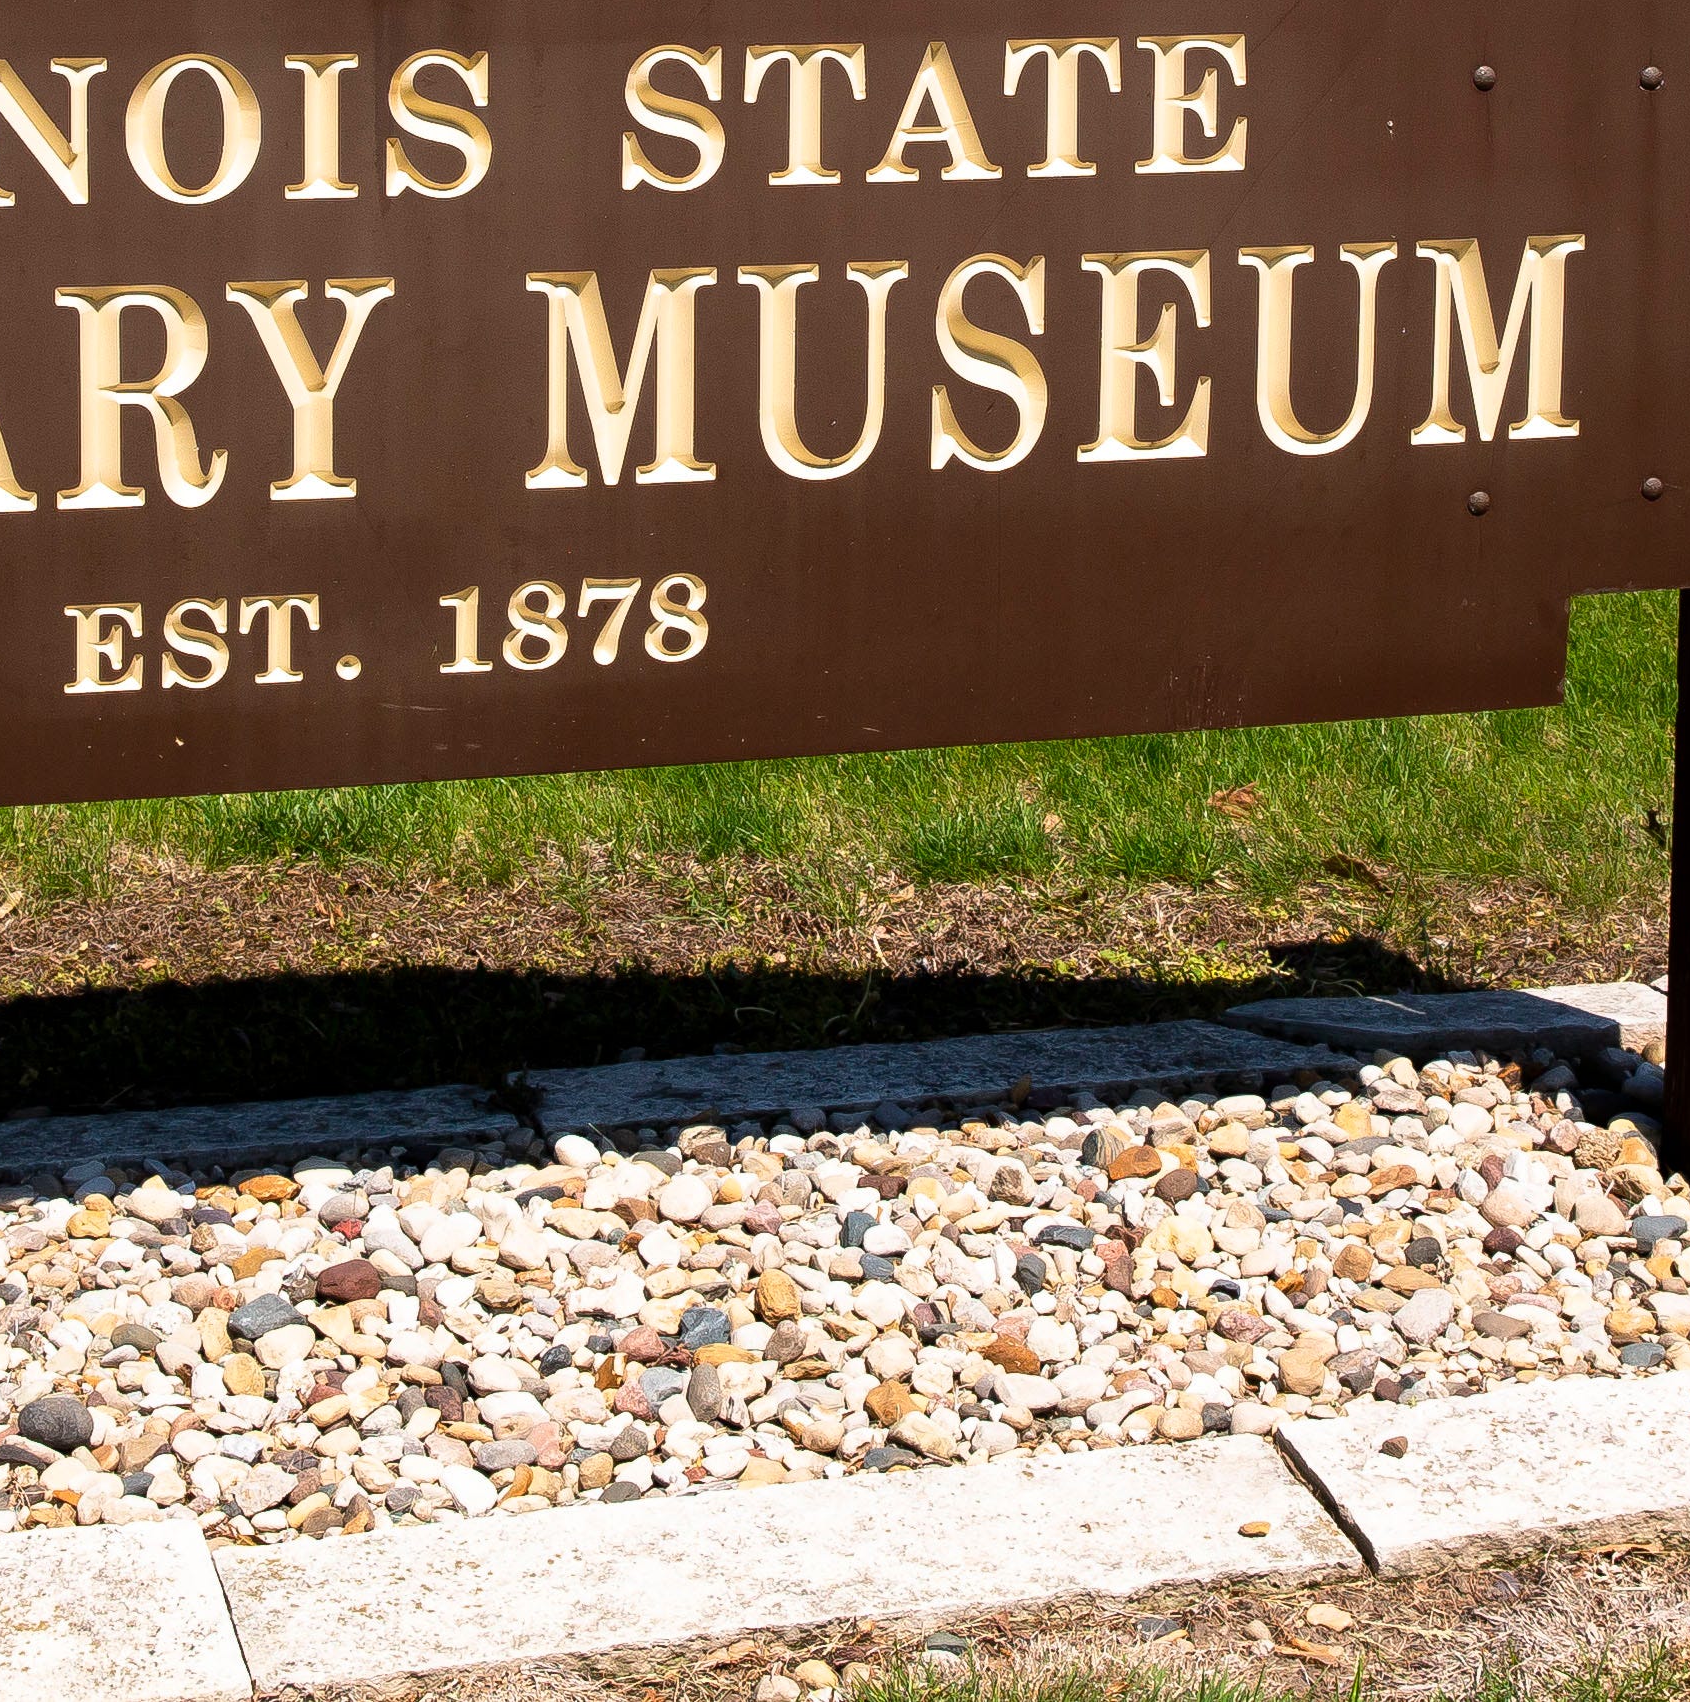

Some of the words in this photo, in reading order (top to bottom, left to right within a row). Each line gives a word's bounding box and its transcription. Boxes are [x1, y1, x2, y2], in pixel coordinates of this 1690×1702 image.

[620, 32, 1249, 193] STATE
[523, 232, 1587, 491] MUSEUM
[62, 592, 363, 696] EST.
[437, 571, 710, 675] 1878
